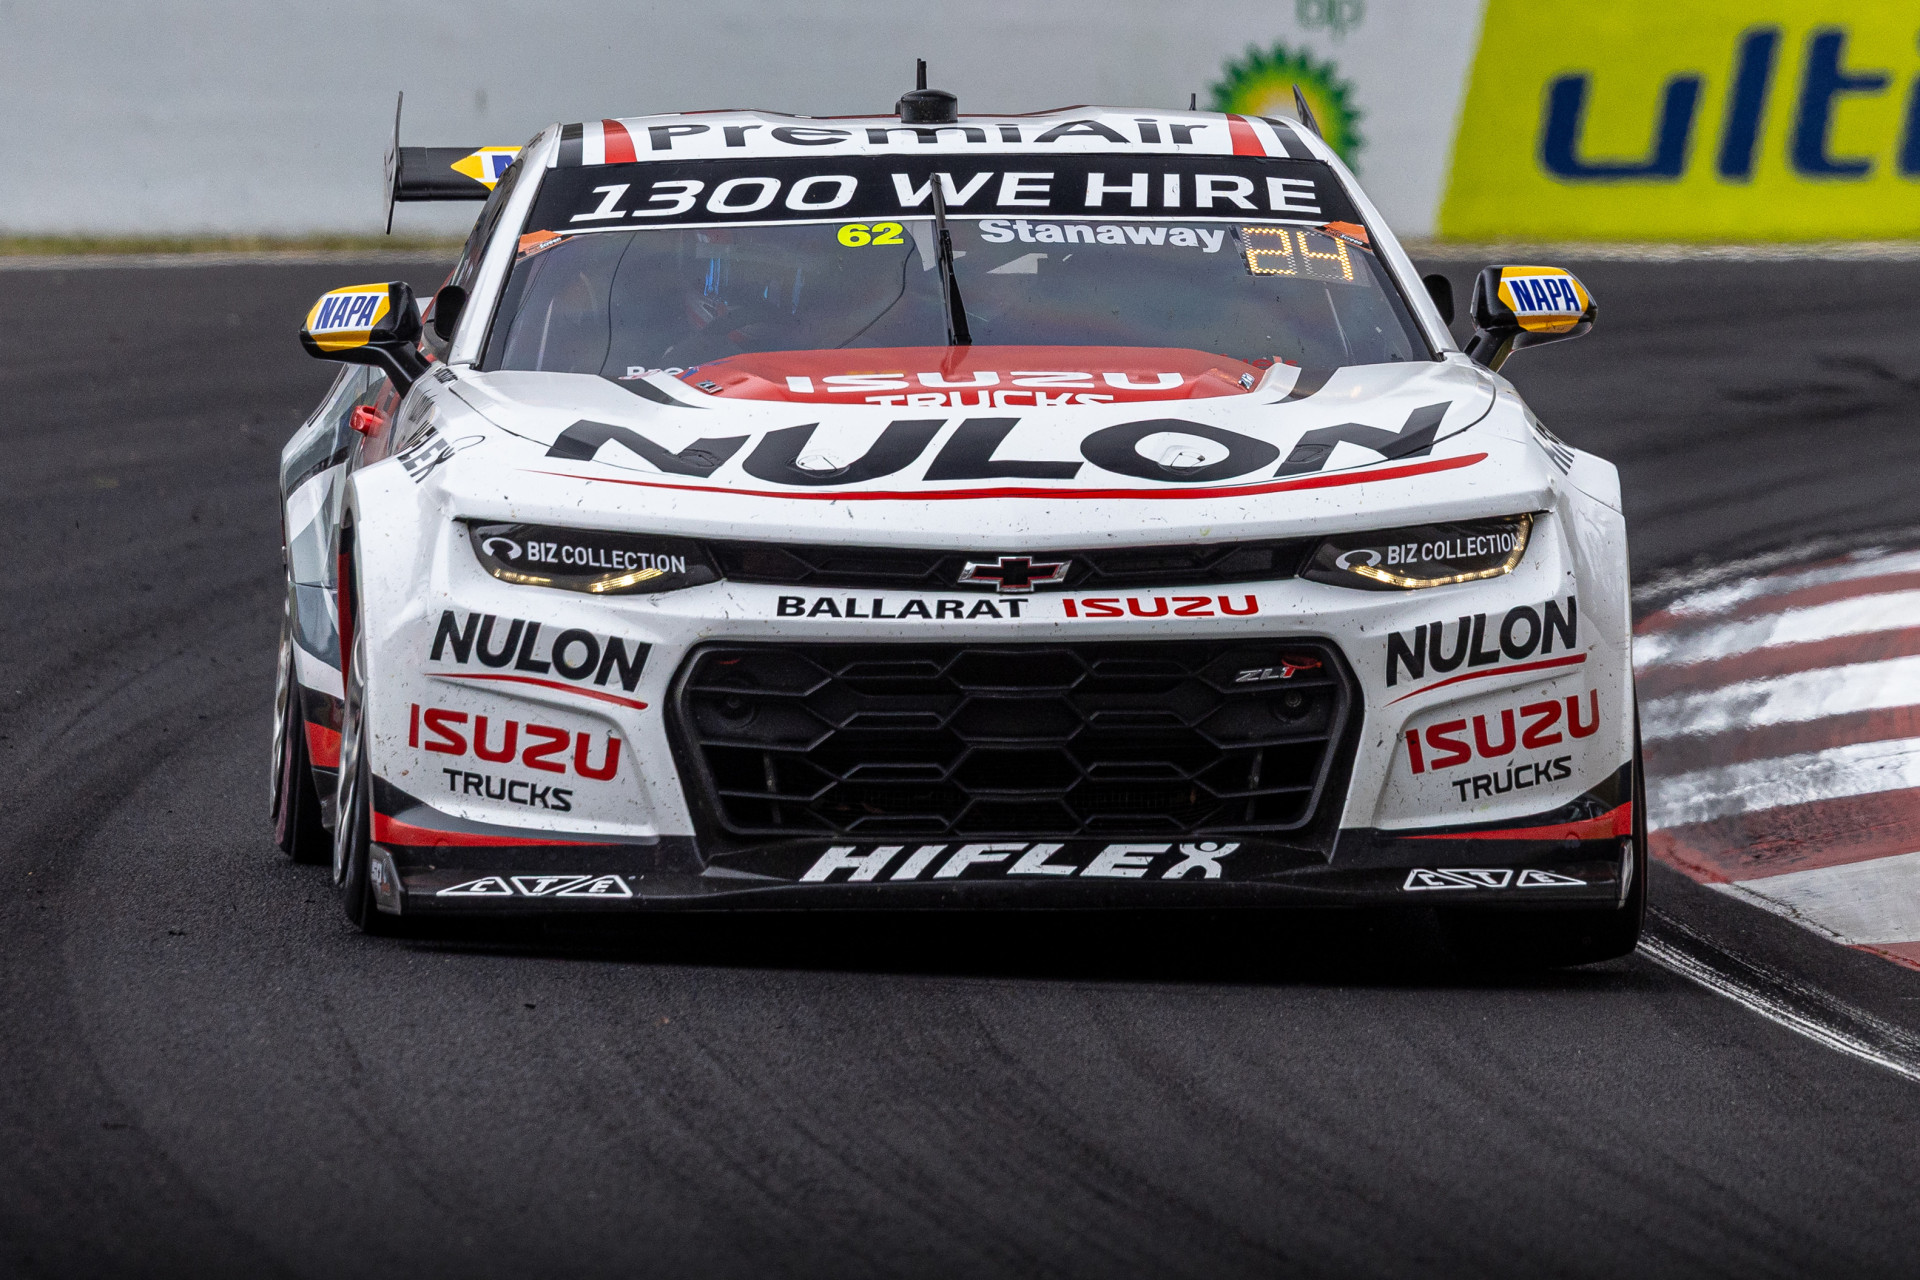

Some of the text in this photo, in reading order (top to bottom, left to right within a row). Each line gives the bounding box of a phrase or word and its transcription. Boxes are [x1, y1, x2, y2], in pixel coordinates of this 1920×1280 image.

[648, 118, 1208, 151] PremiAir
[570, 172, 1321, 222] 1300 WE HIRE
[837, 222, 904, 248] 62
[978, 219, 1225, 253] Stanaway
[1242, 227, 1353, 281] 24
[315, 295, 381, 331] NAPA
[1510, 277, 1582, 312] NAPA
[785, 371, 1185, 394] ISUZU
[544, 399, 1454, 487] NULON
[527, 541, 686, 574] BIZ COLLECTION
[1387, 532, 1522, 565] BIZ COLLECTION
[776, 594, 1259, 619] BALLARAT ISUZU
[429, 609, 653, 693] NULON
[1386, 596, 1577, 688] NULON
[408, 702, 622, 782] ISUZU
[1405, 688, 1601, 775] ISUZU
[442, 767, 574, 813] TRUCKS
[1451, 755, 1572, 803] TRUCKS
[799, 842, 1240, 882] HIFLEX
